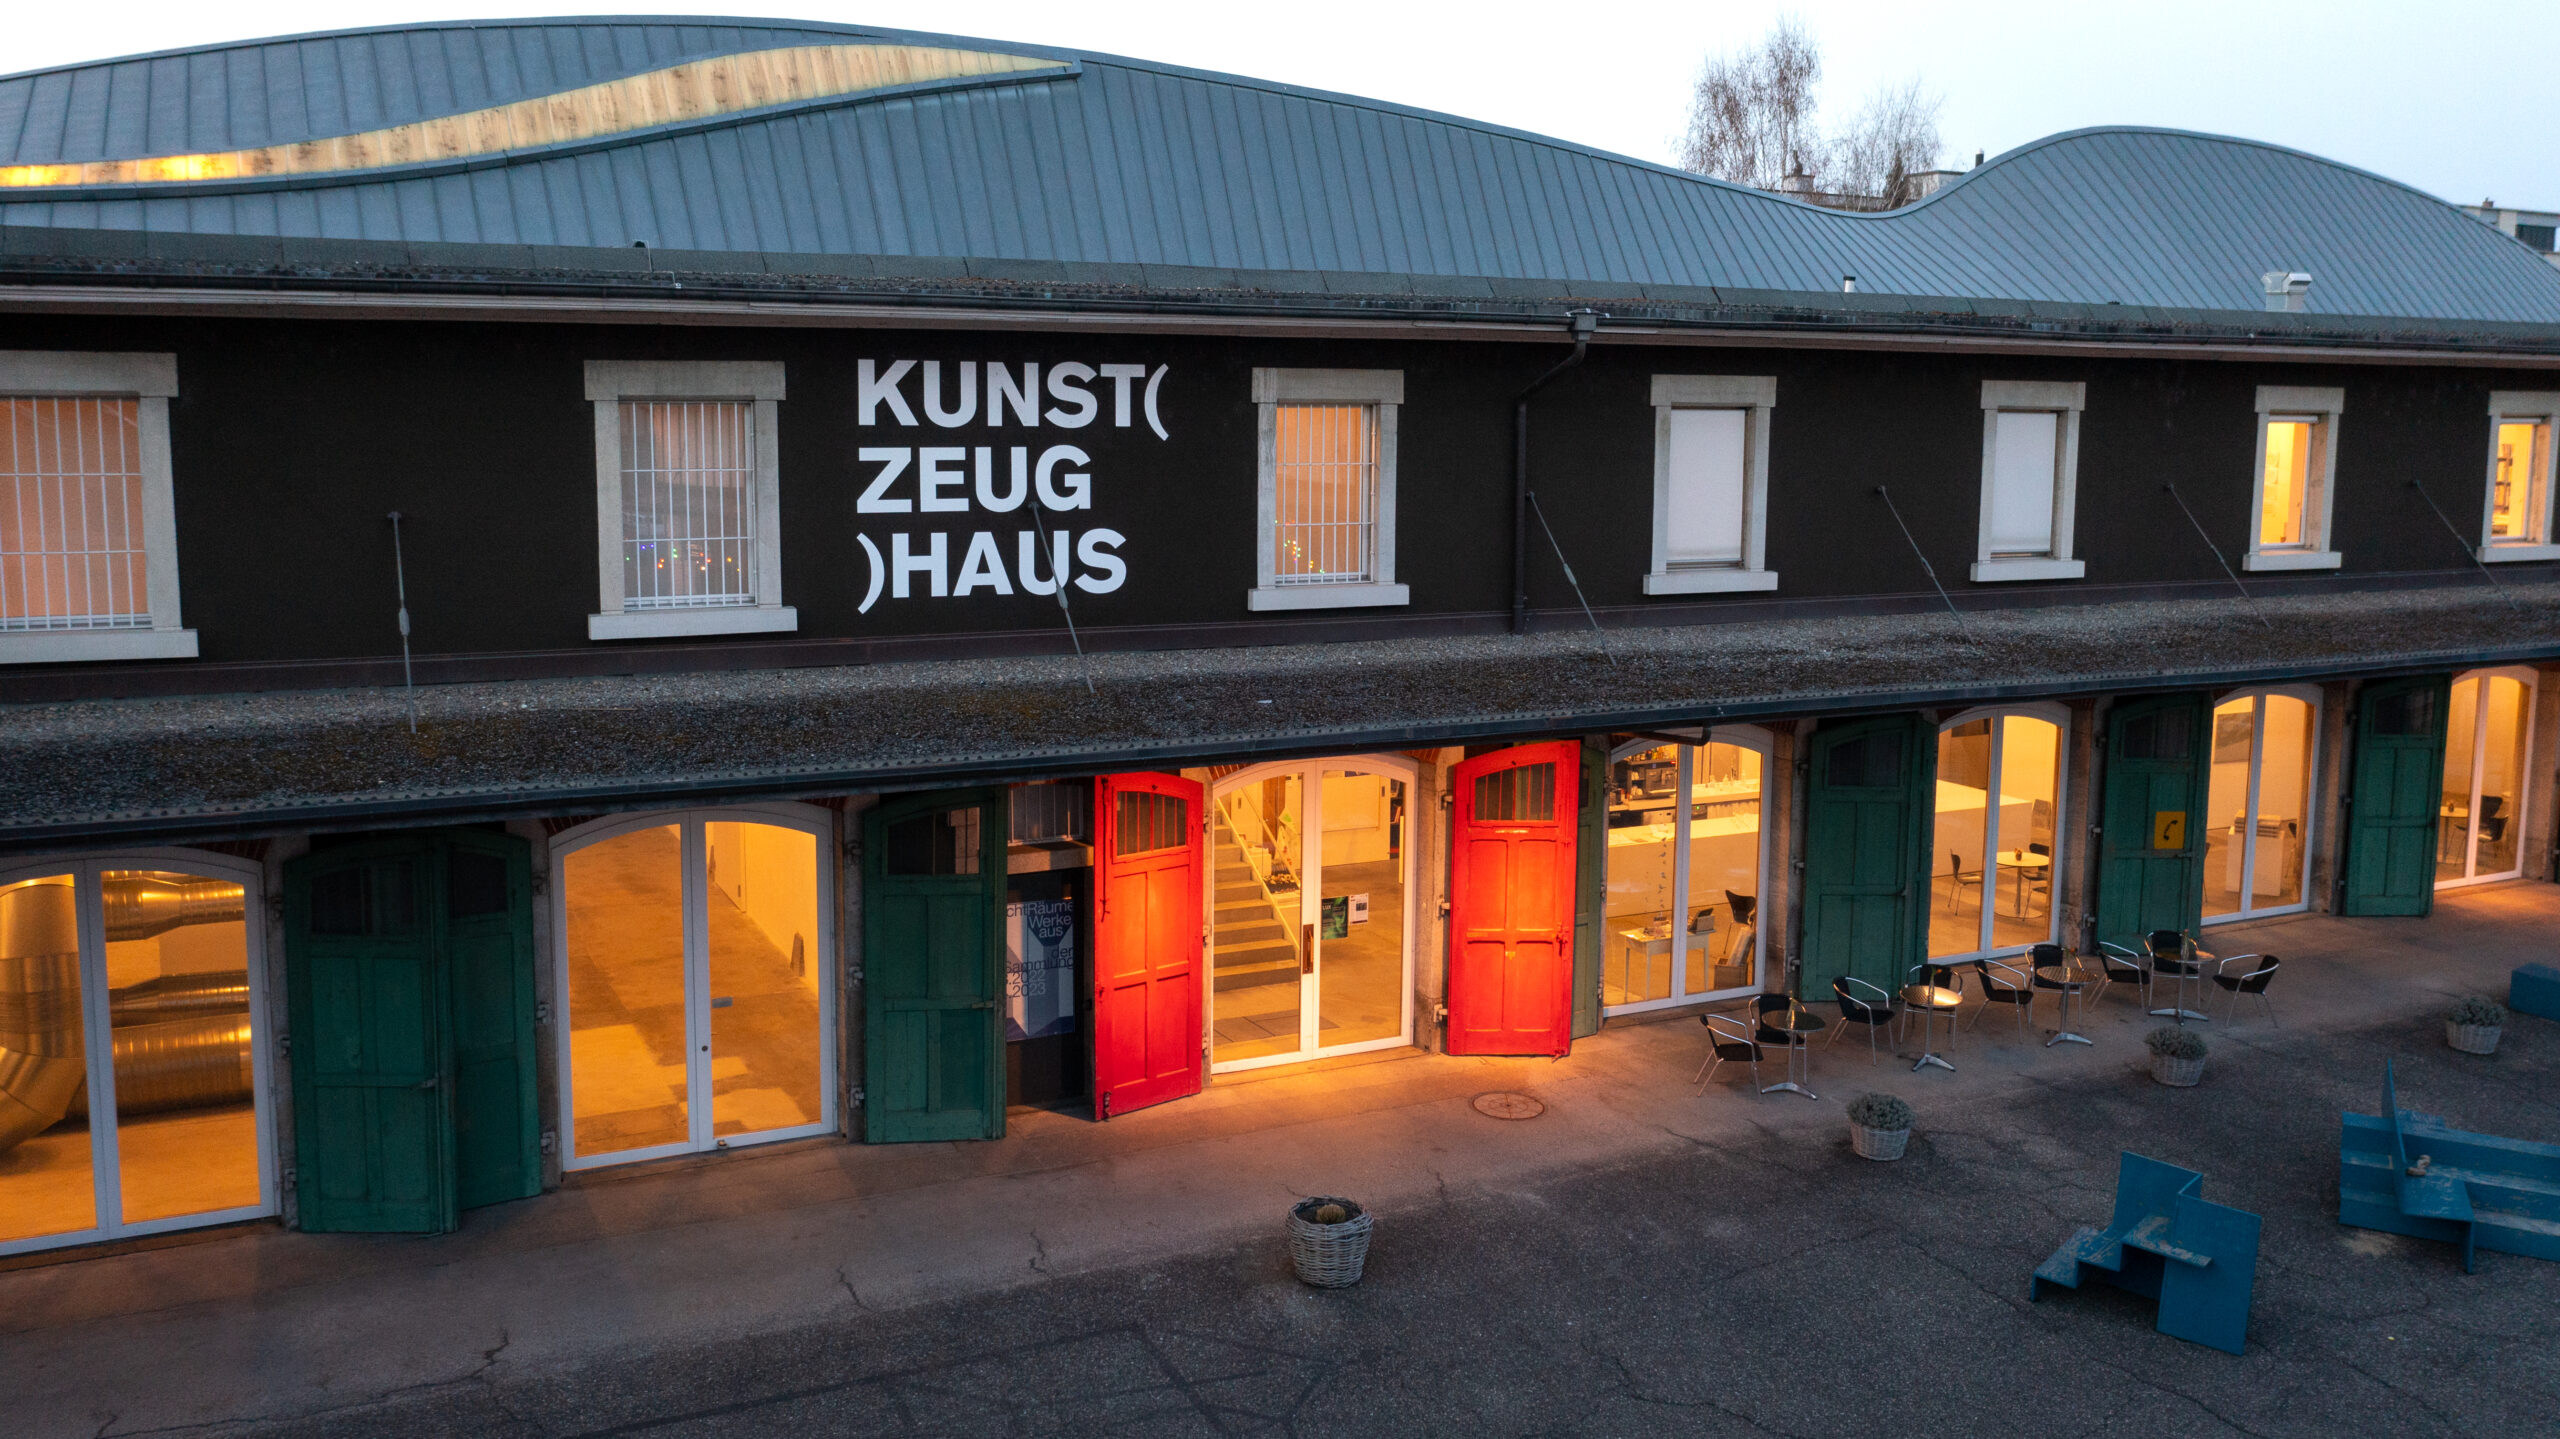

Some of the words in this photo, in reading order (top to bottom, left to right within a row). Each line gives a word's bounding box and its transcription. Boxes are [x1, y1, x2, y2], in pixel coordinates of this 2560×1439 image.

[857, 358, 1169, 442] KUNST(
[856, 444, 1092, 514] ZEUG
[856, 527, 1127, 615] )HAUS
[1006, 901, 1073, 918] chtRäume
[1029, 914, 1072, 928] Werke
[1039, 926, 1063, 938] aus
[1005, 956, 1073, 973] Sammlung
[1005, 969, 1046, 985] .2022
[1005, 981, 1046, 998] .2023
